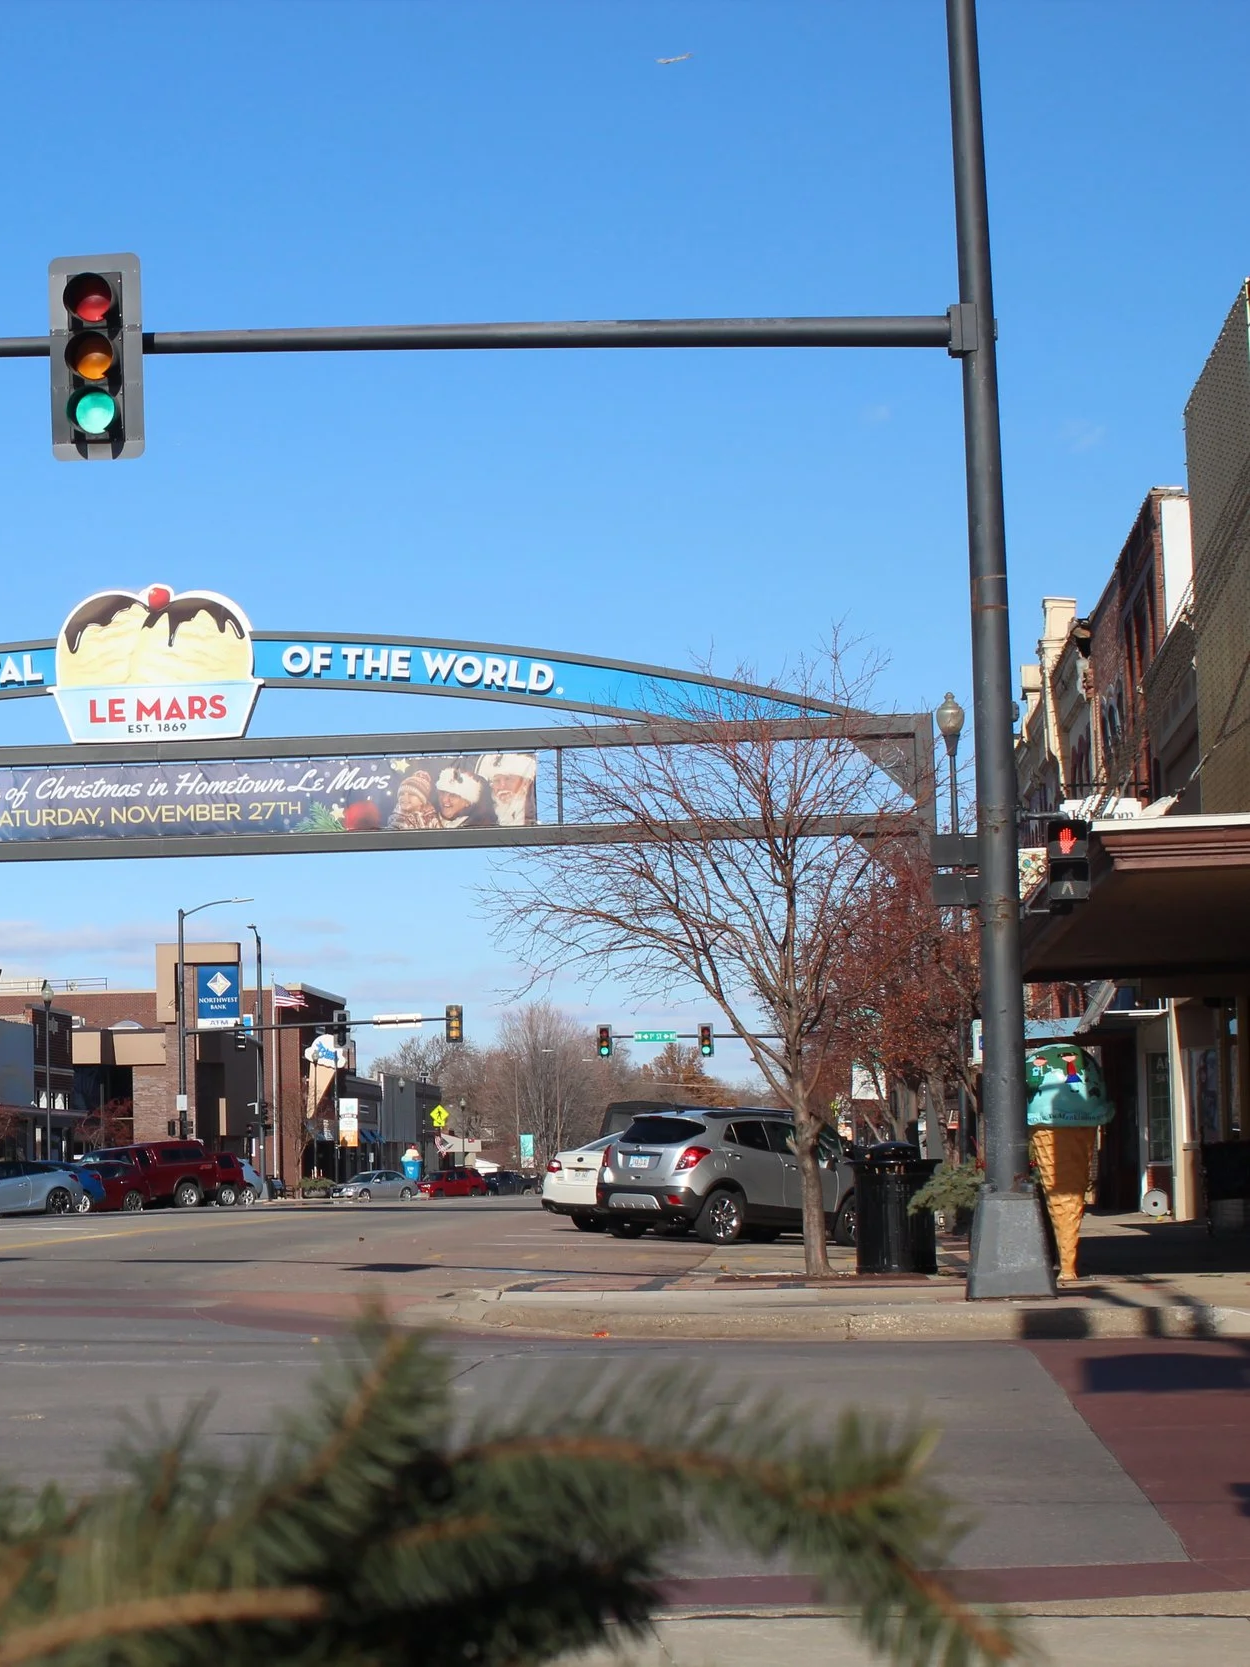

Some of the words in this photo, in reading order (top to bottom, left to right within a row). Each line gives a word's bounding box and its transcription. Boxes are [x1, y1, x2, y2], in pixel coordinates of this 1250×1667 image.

[281, 645, 332, 674] OF
[341, 647, 411, 679] THE
[89, 698, 126, 723] LE
[136, 694, 227, 721] MARS
[127, 724, 153, 734] EST.
[158, 722, 188, 733] 1869
[4, 777, 32, 809] of
[35, 776, 143, 801] Christmas
[146, 777, 169, 797] in
[174, 772, 287, 797] Hometown
[286, 768, 325, 793] Le
[325, 767, 391, 794] Mars
[110, 802, 241, 825] NOVEMBER
[248, 801, 301, 822] 27TH
[198, 996, 238, 1004] NORTHWEST
